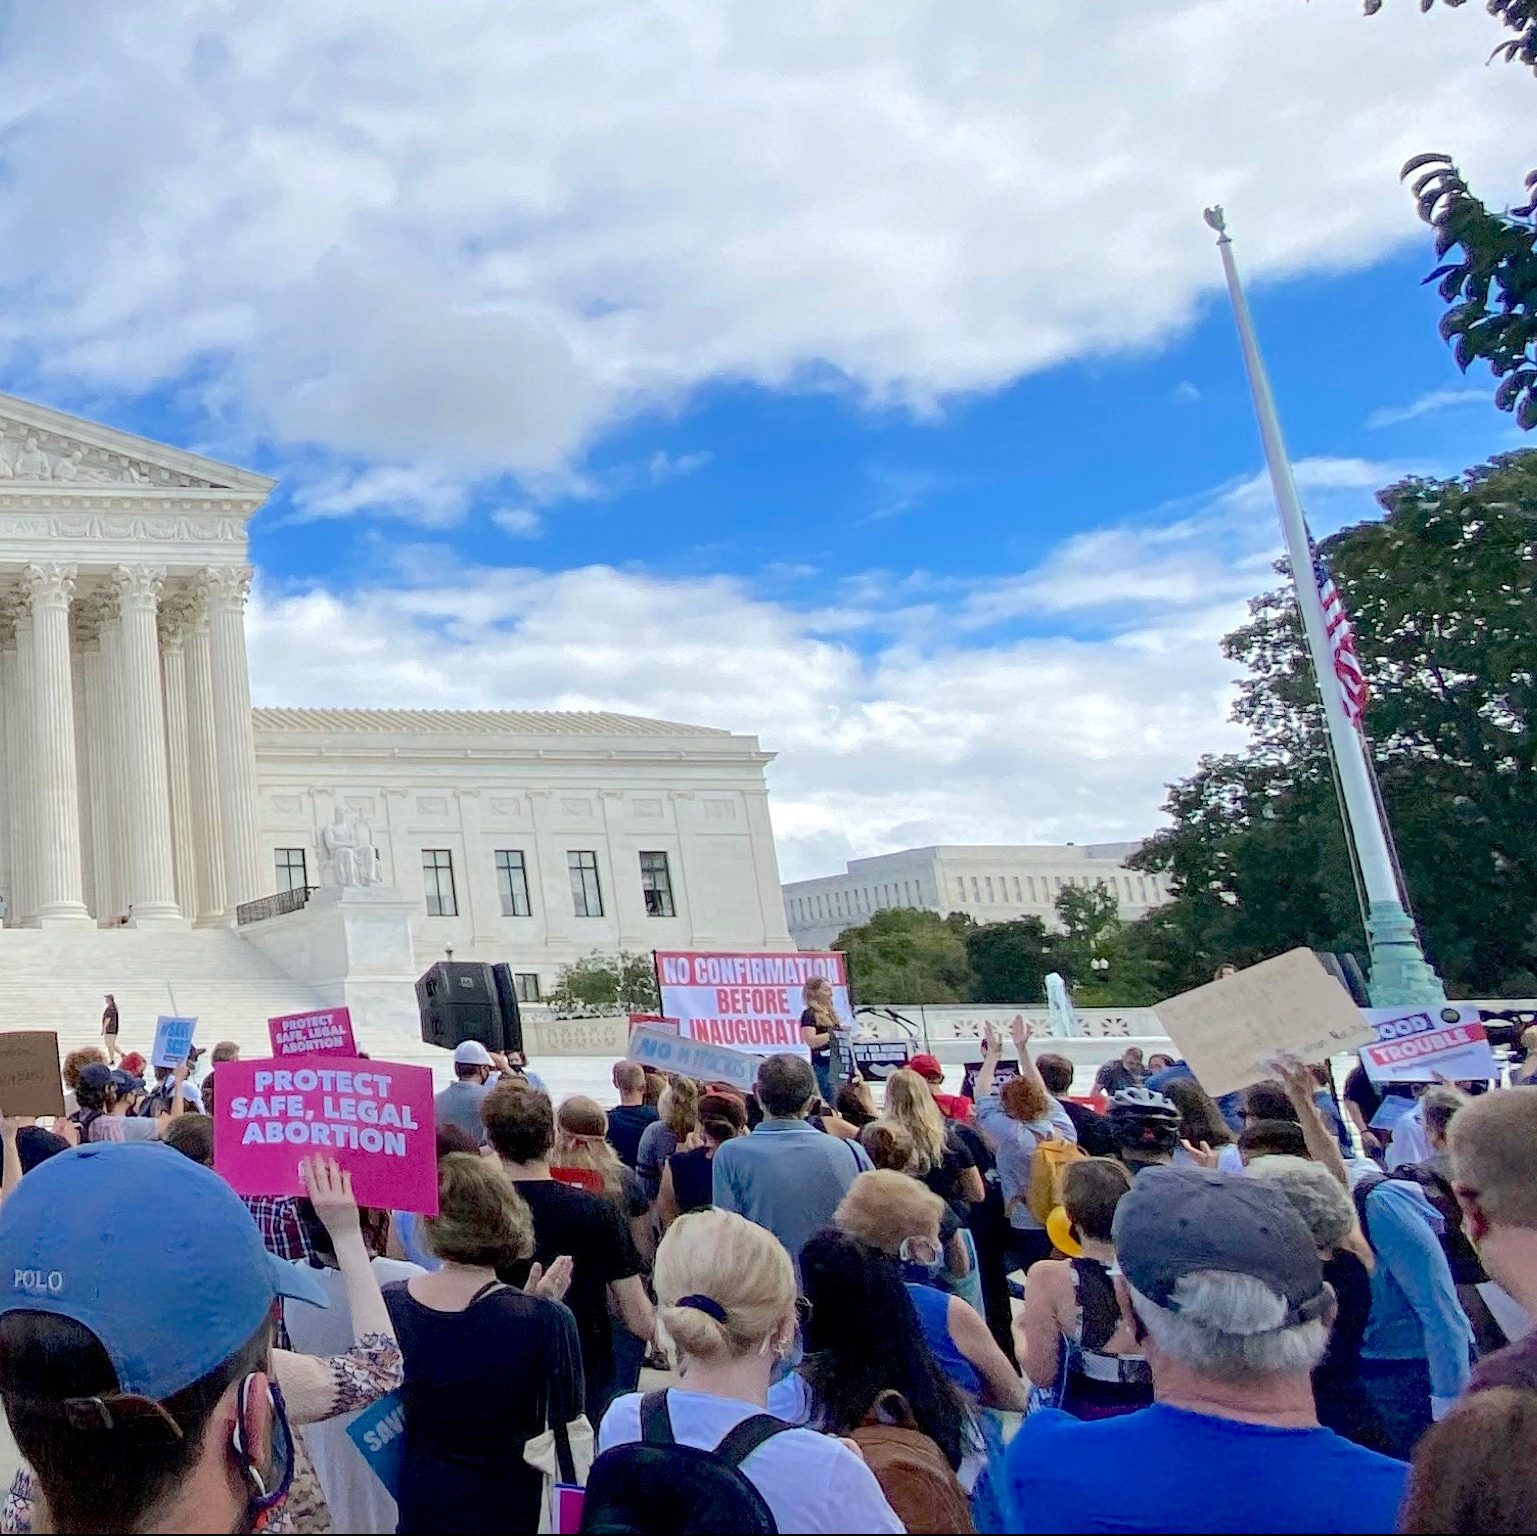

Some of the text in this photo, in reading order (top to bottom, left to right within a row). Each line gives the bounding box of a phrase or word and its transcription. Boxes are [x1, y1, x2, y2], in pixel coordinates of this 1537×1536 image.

[4, 520, 40, 533] LAW
[662, 957, 840, 985] NO CONFIRMATION
[716, 988, 791, 1015] BEFORE
[276, 1025, 346, 1044] SAFE, LEGAL
[282, 1014, 332, 1031] PROTECT
[690, 1018, 805, 1045] INAUGURAT
[1376, 1015, 1428, 1040] OOD
[282, 1036, 343, 1054] ABORTION
[635, 1038, 672, 1059] NO
[1374, 1027, 1472, 1062] TROUBLE
[255, 1069, 392, 1098] PROTECT
[231, 1095, 418, 1131] SAFE, LEGAL
[242, 1121, 407, 1157] ABORTION
[14, 1268, 63, 1290] POLO
